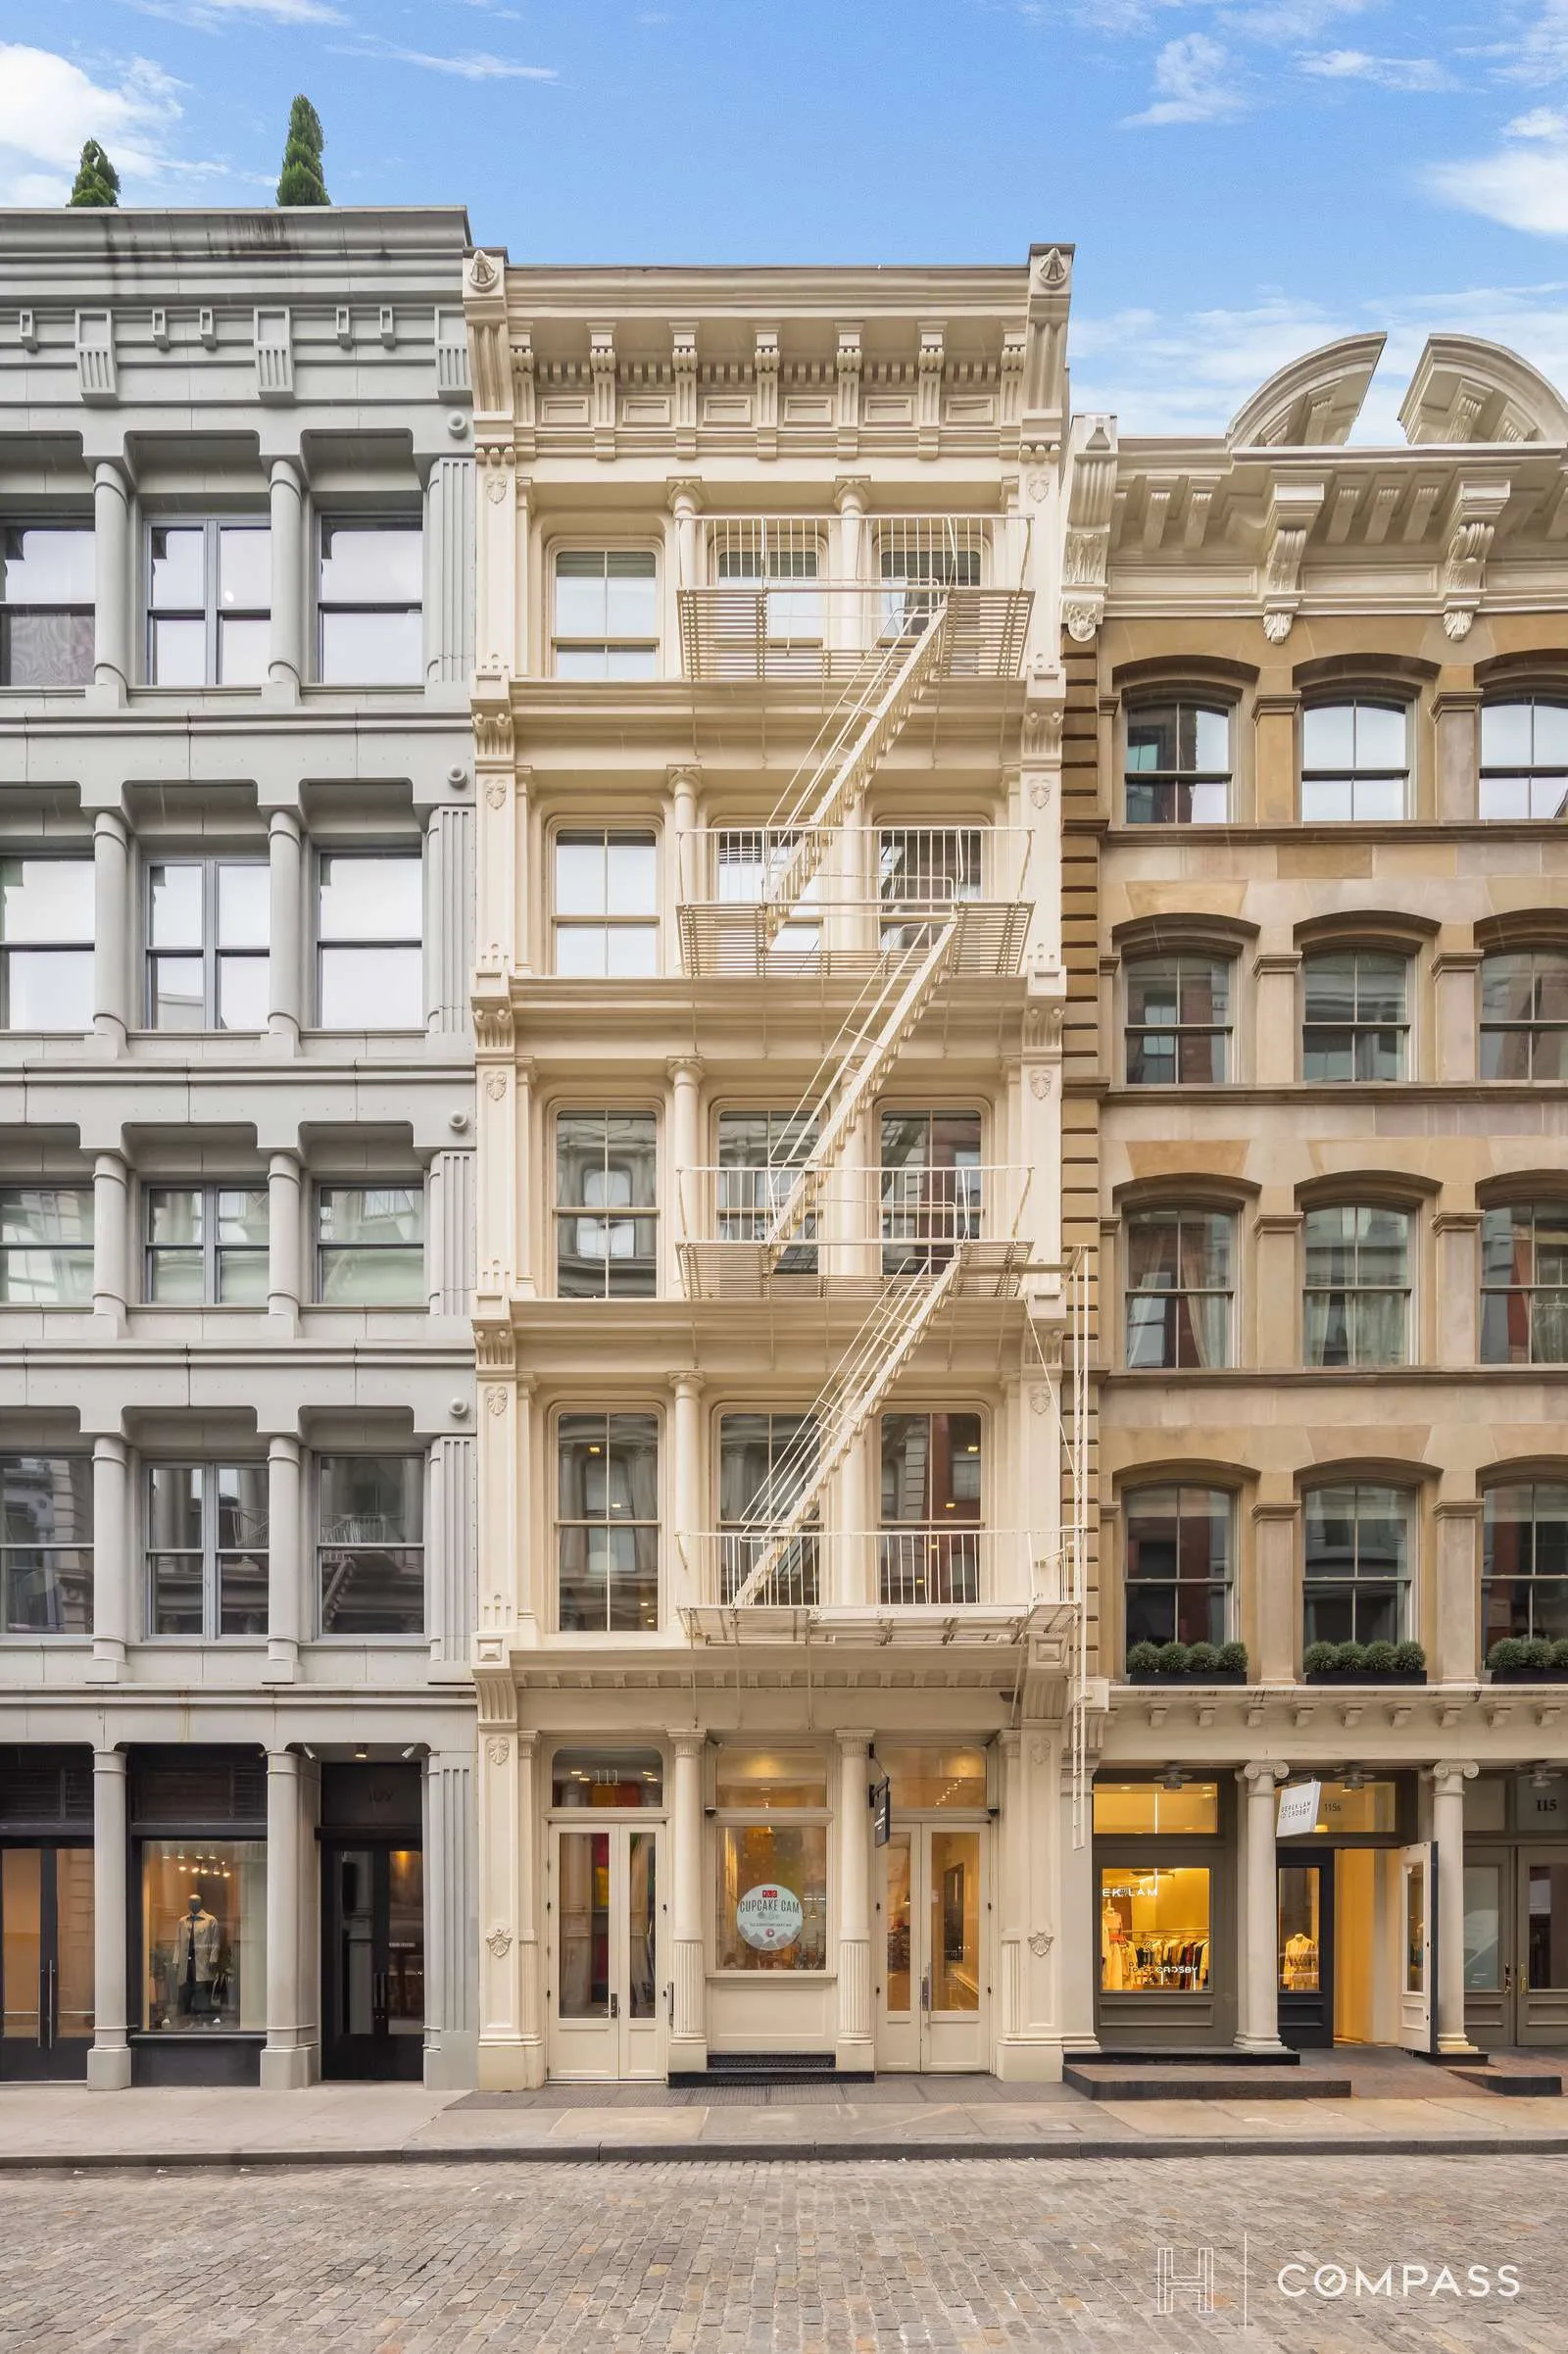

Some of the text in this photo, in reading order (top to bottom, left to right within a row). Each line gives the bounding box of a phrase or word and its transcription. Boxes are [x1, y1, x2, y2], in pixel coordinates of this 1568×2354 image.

[594, 1769, 620, 1786] 111
[1537, 1798, 1557, 1812] 115
[1128, 1888, 1158, 1897] LAM
[740, 1899, 779, 1913] CUPCAKE
